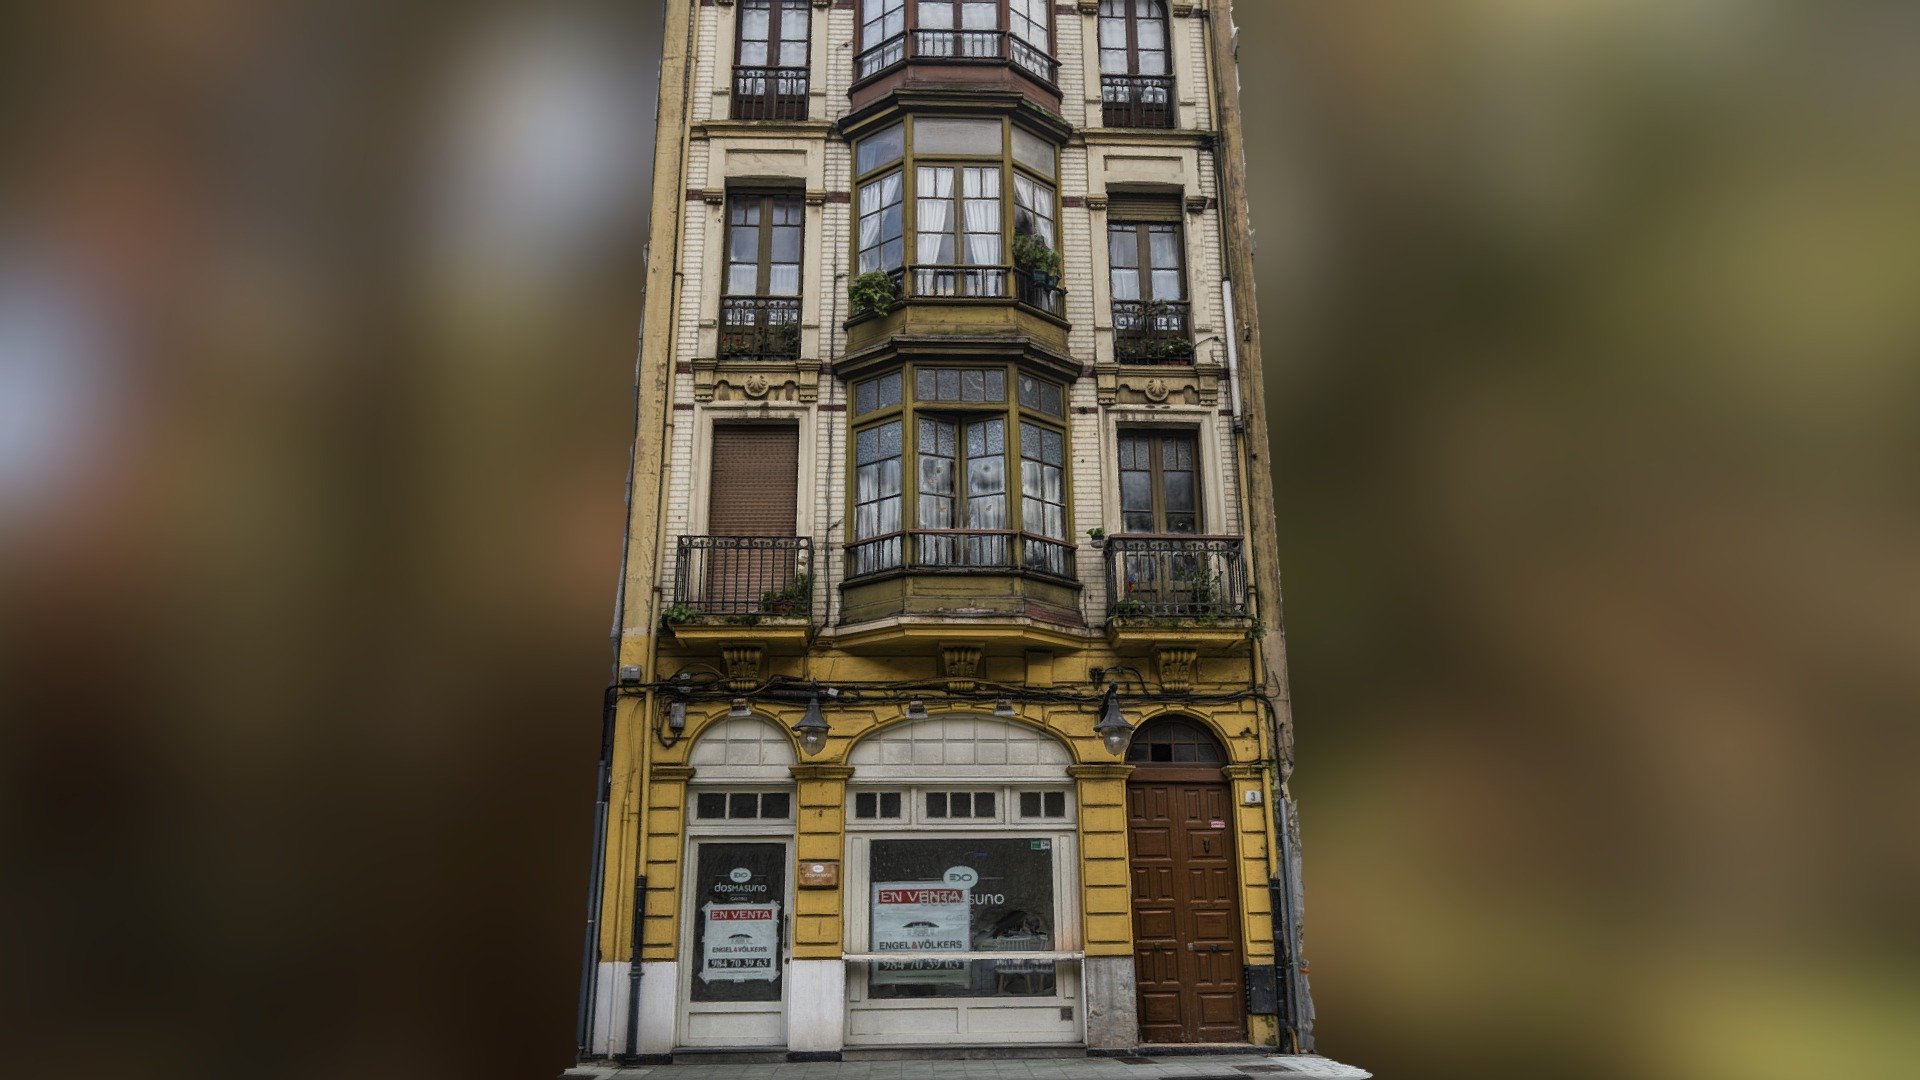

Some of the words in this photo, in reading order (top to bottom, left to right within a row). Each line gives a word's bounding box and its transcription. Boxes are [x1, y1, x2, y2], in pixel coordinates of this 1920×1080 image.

[1250, 792, 1256, 801] 3
[881, 892, 902, 903] EN
[909, 890, 961, 903] VENTA
[711, 911, 728, 919] EN
[731, 910, 771, 919] VENTA
[879, 939, 963, 950] ENGEL&VÖLKERS
